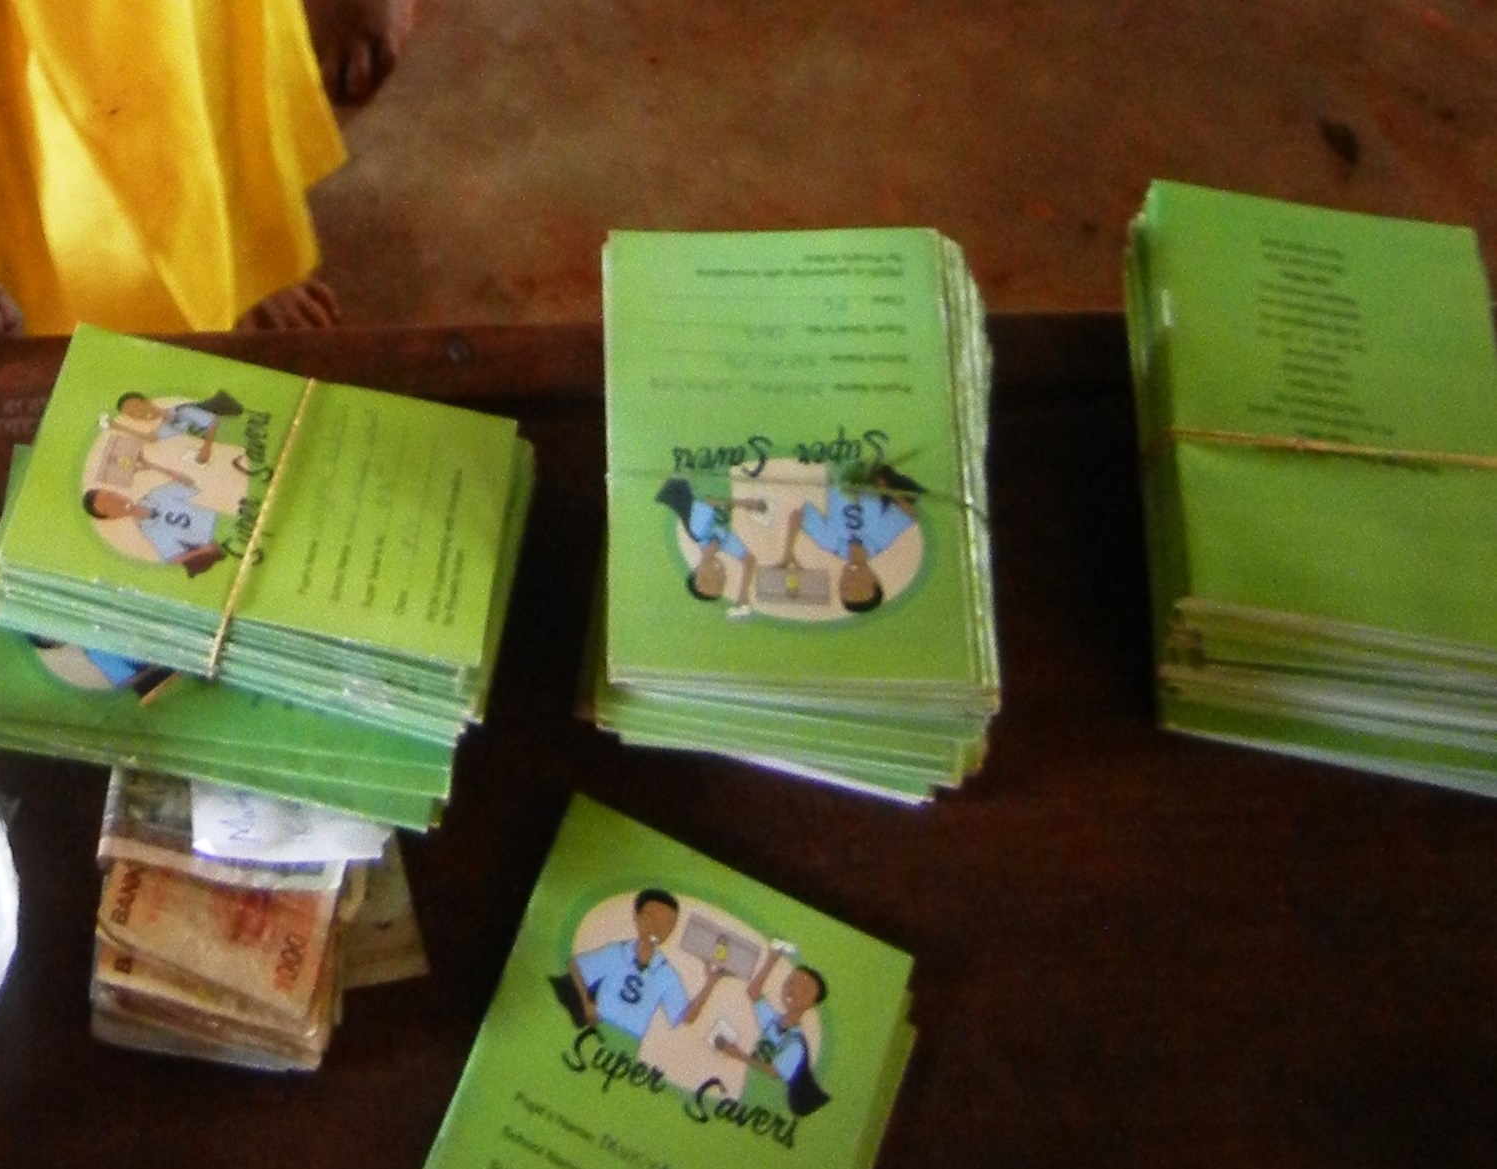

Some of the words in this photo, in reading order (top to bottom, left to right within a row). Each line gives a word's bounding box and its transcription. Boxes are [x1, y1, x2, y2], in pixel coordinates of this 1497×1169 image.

[619, 973, 645, 1005] S
[561, 1026, 666, 1094] Super
[684, 1077, 798, 1150] Savers
